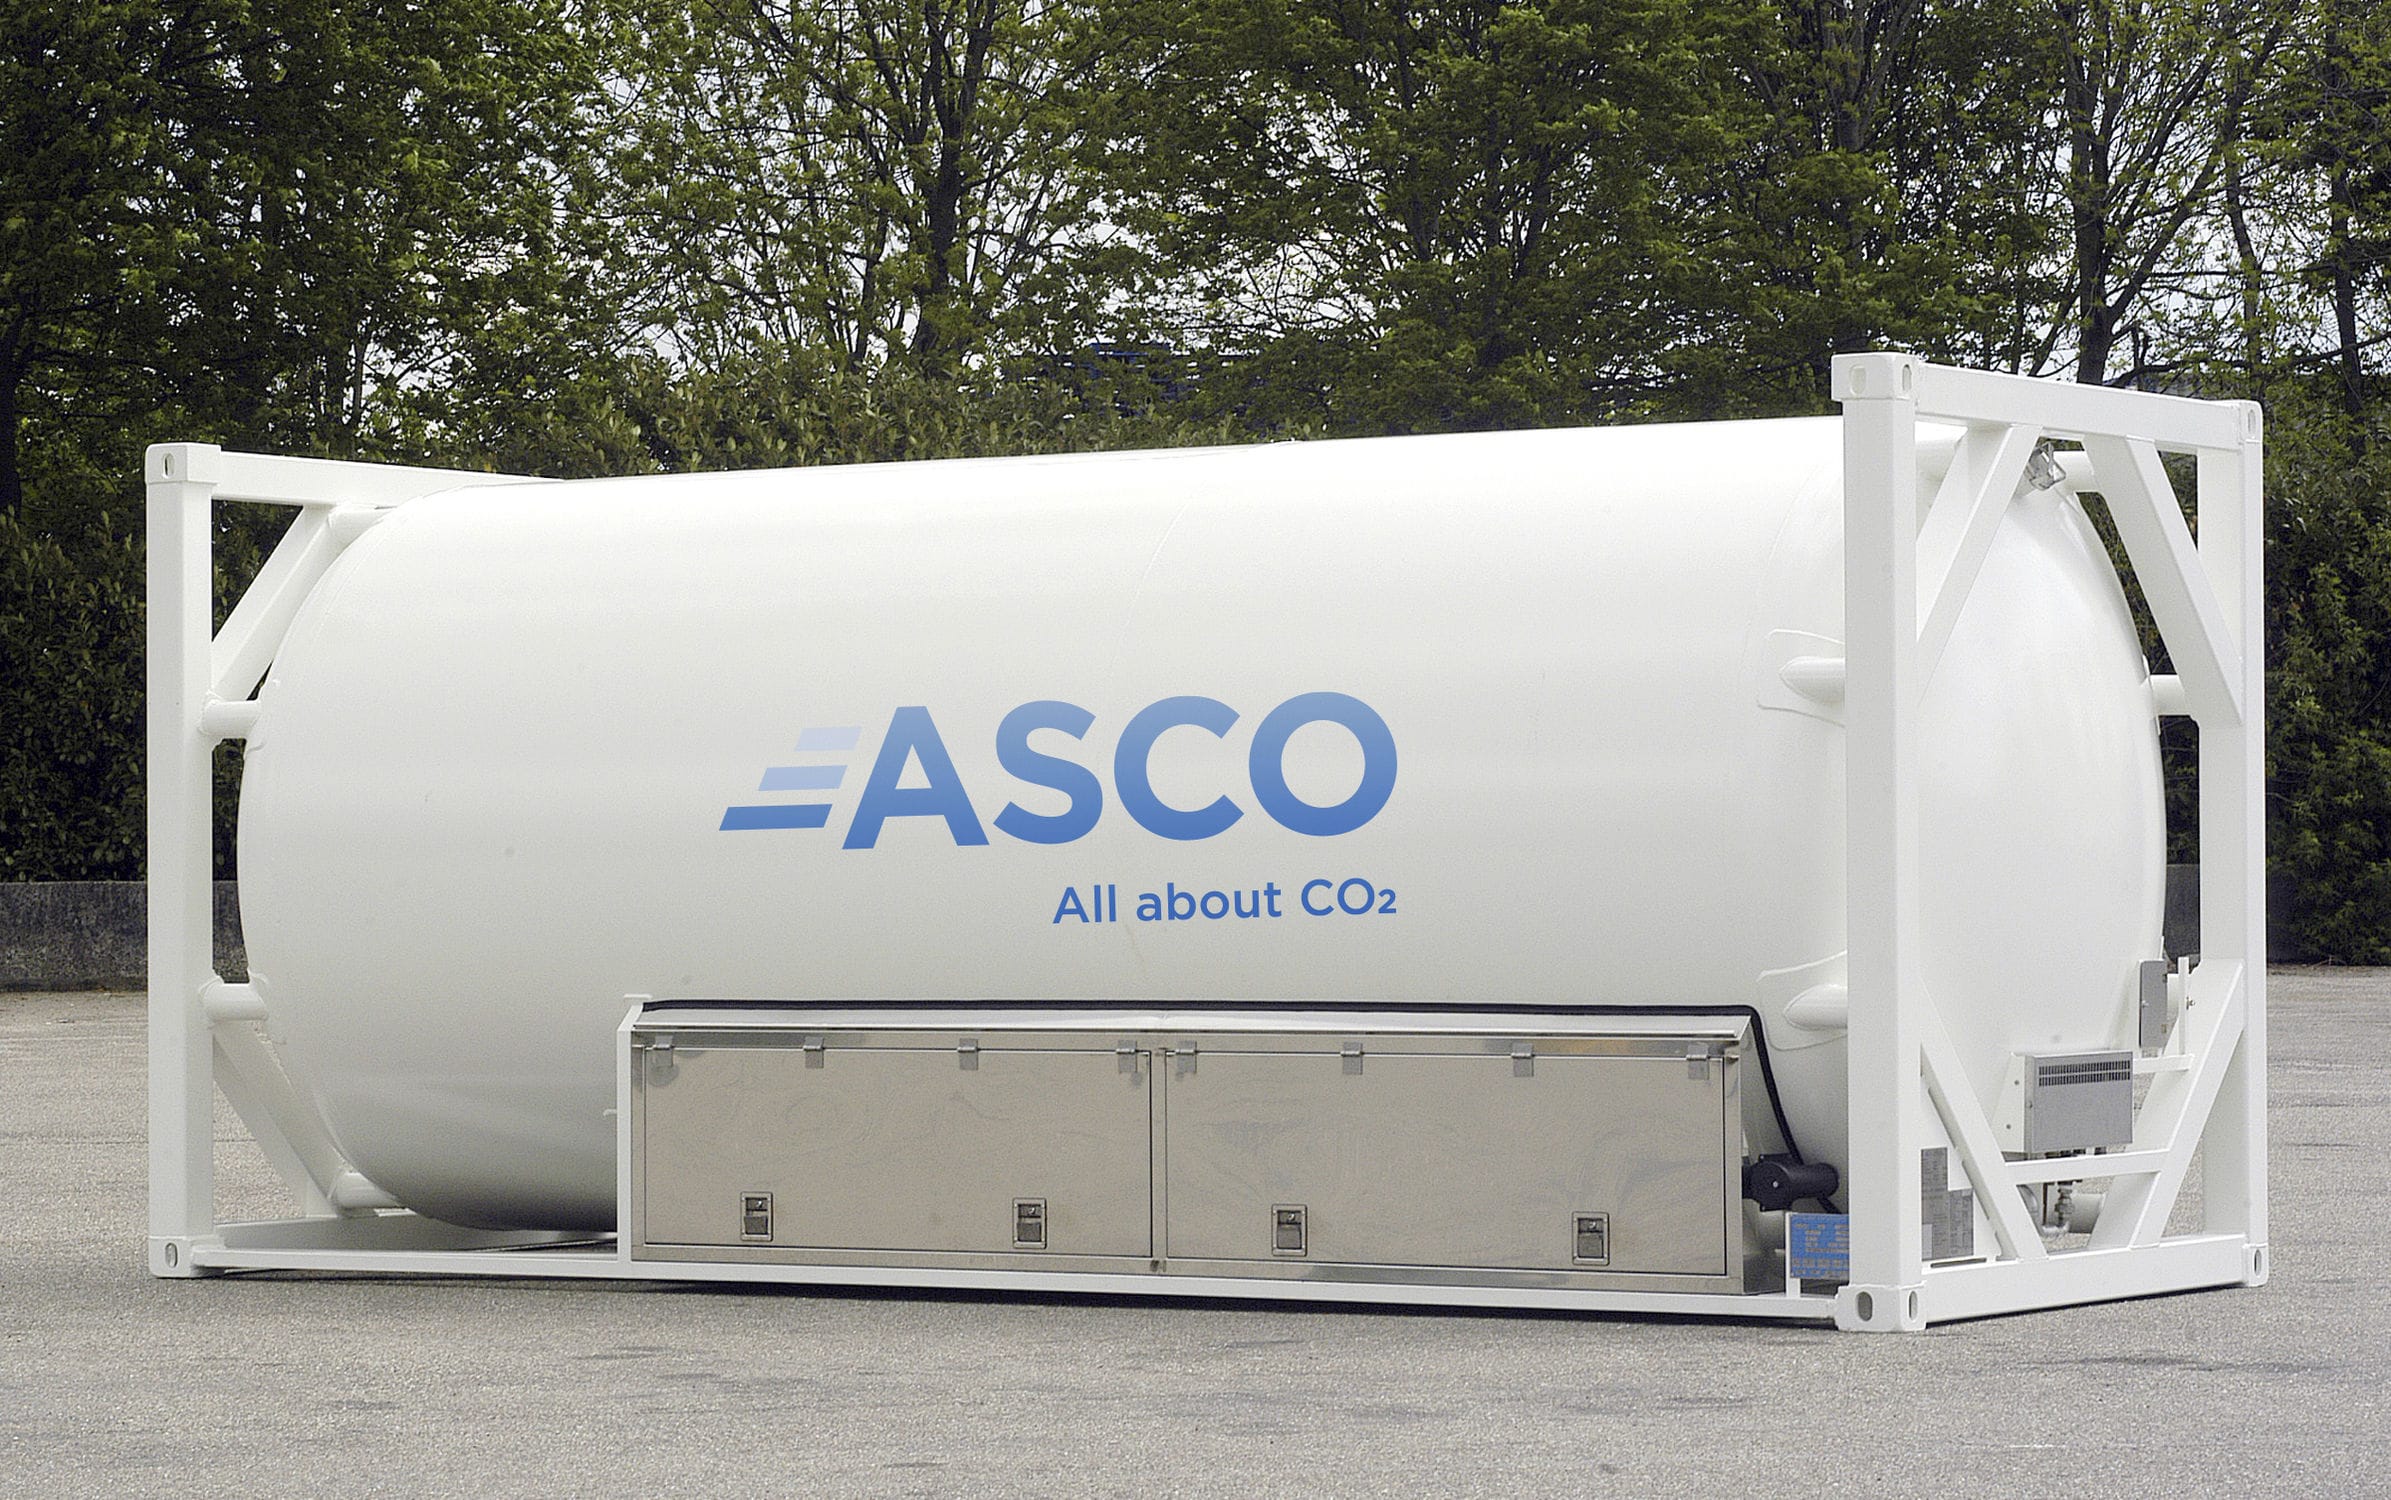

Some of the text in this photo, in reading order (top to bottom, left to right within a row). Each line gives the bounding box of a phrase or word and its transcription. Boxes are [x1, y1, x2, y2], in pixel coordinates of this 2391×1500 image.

[841, 691, 1399, 851] ASCO
[1052, 877, 1398, 925] All about CO2
